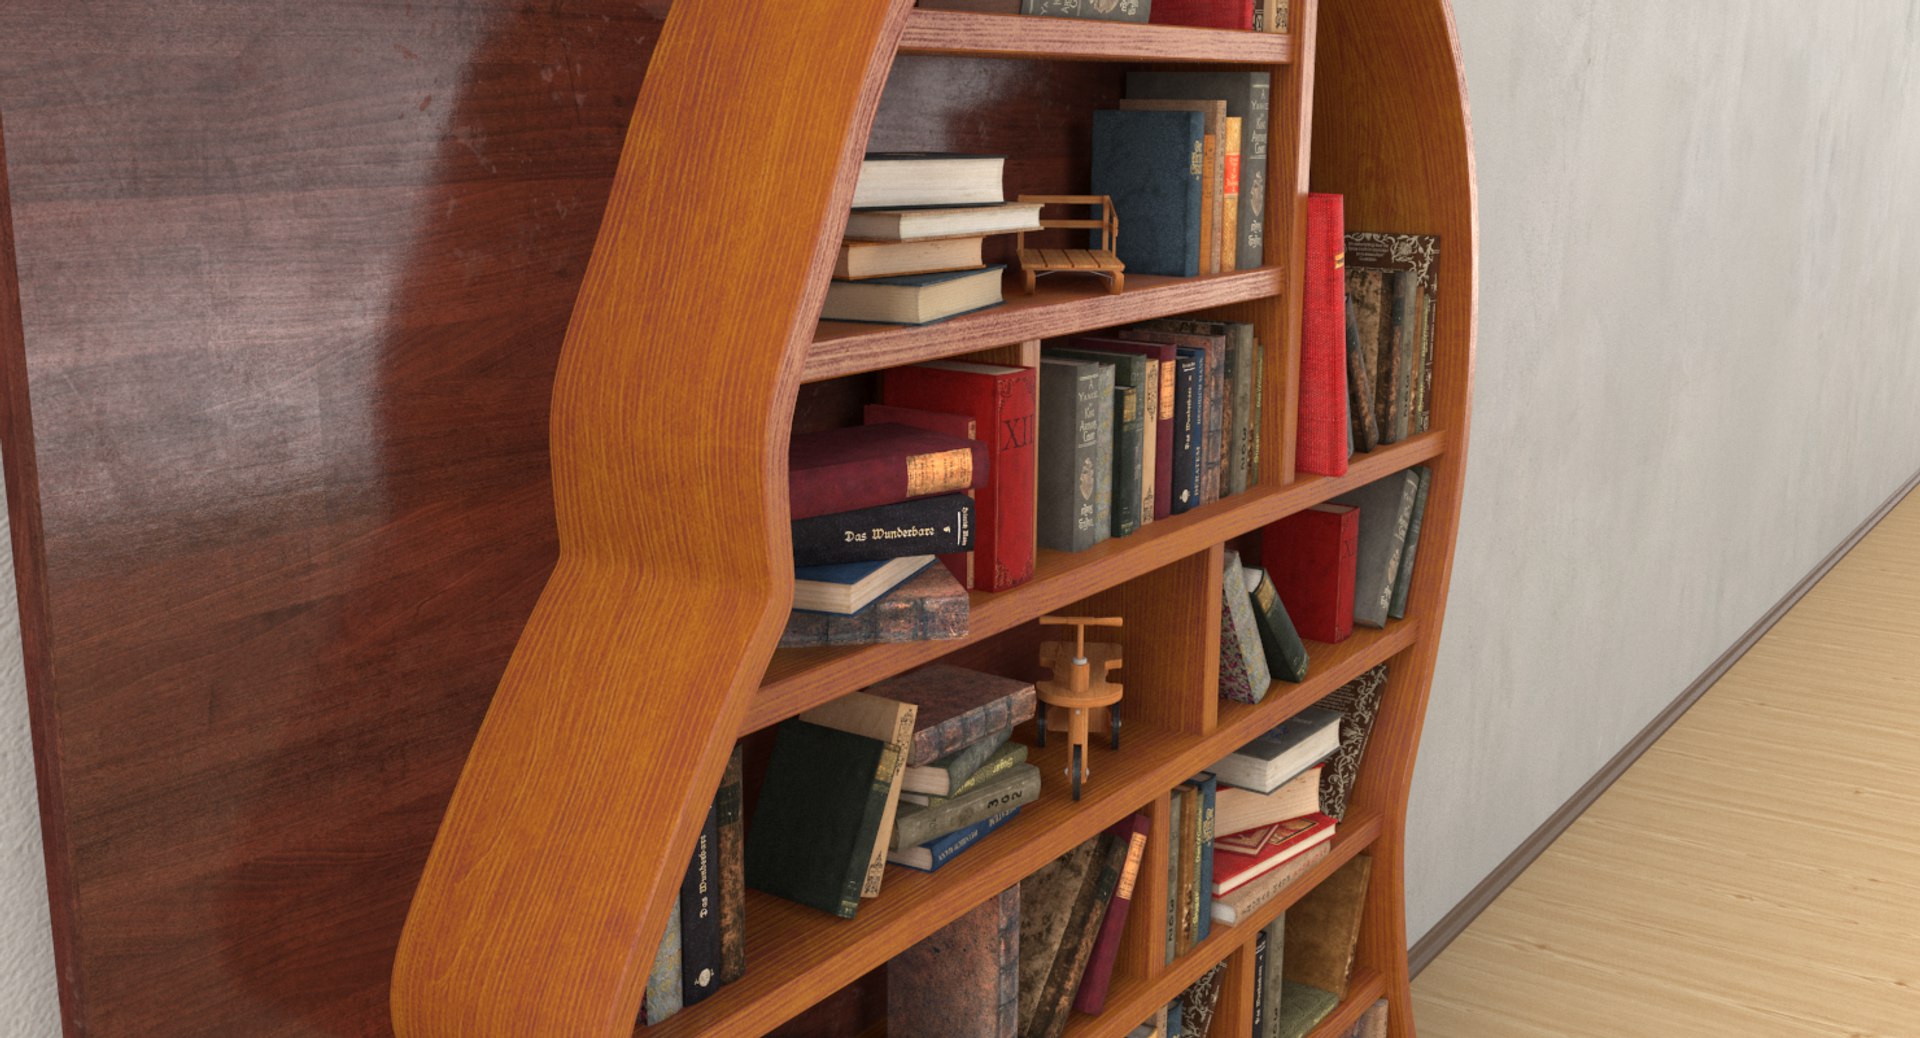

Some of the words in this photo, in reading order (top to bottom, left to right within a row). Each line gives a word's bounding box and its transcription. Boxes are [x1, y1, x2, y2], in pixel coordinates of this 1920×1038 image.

[844, 530, 867, 542] Das
[872, 525, 935, 541] Wunderbare
[698, 834, 708, 894] Wunderbare
[698, 896, 708, 918] Das
